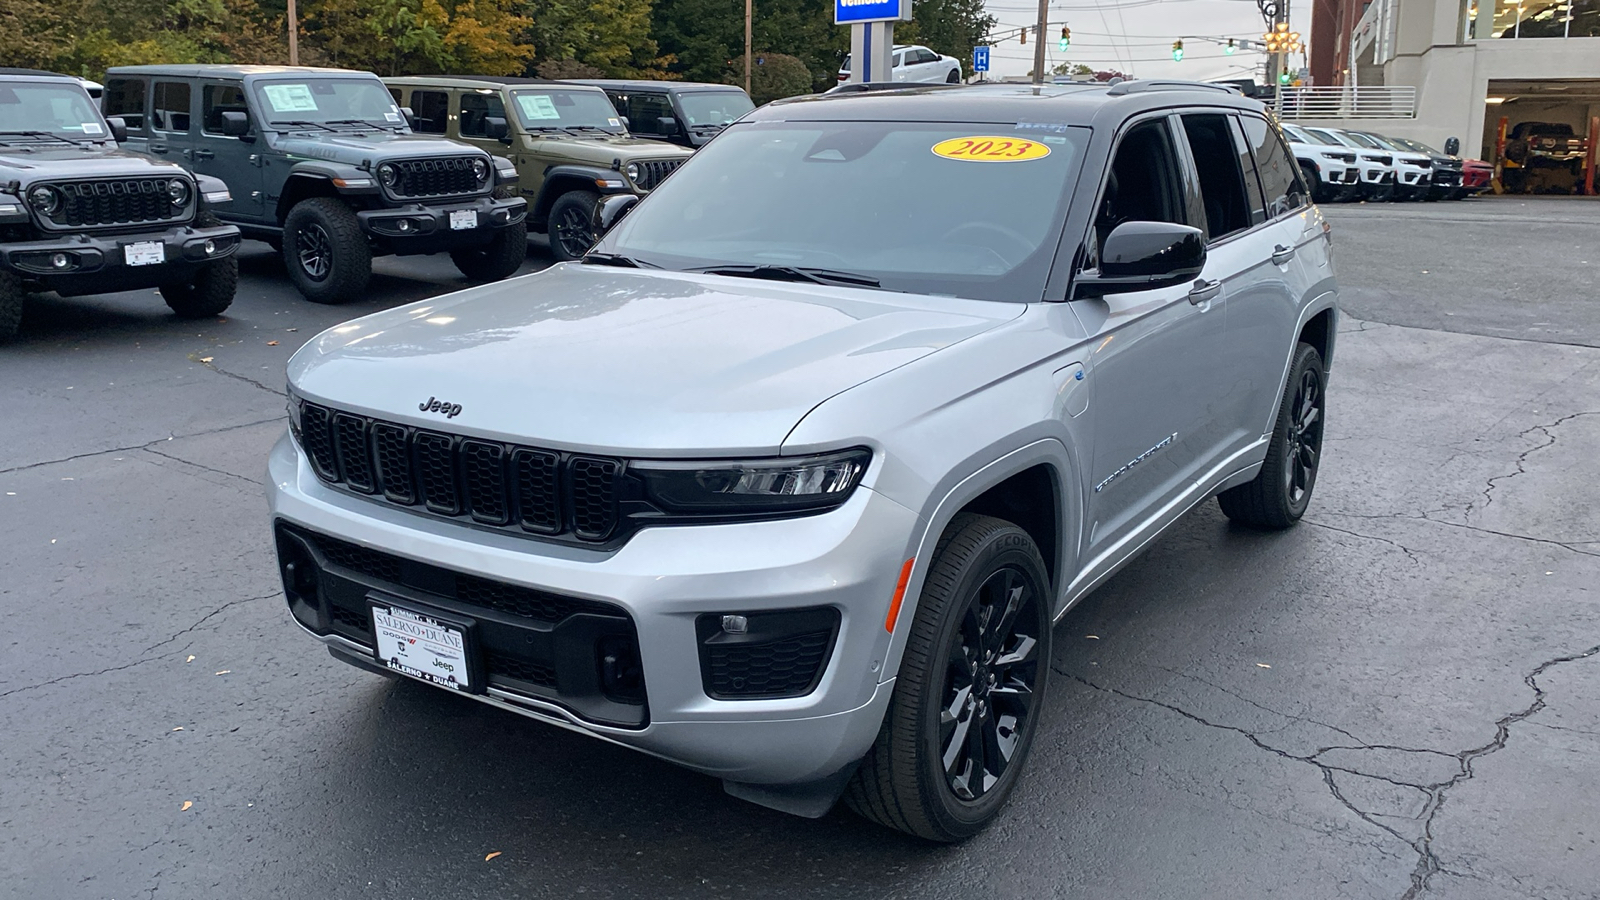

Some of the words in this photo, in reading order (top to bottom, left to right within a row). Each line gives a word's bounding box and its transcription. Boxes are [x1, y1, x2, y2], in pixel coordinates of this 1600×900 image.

[977, 52, 987, 64] H
[948, 140, 1033, 157] 2023
[418, 396, 463, 419] Jeep
[376, 614, 421, 636] SALERNO
[426, 626, 462, 648] DUANE
[386, 661, 422, 678] SALERNO
[432, 675, 459, 690] DUANE
[432, 658, 454, 673] Jeep
